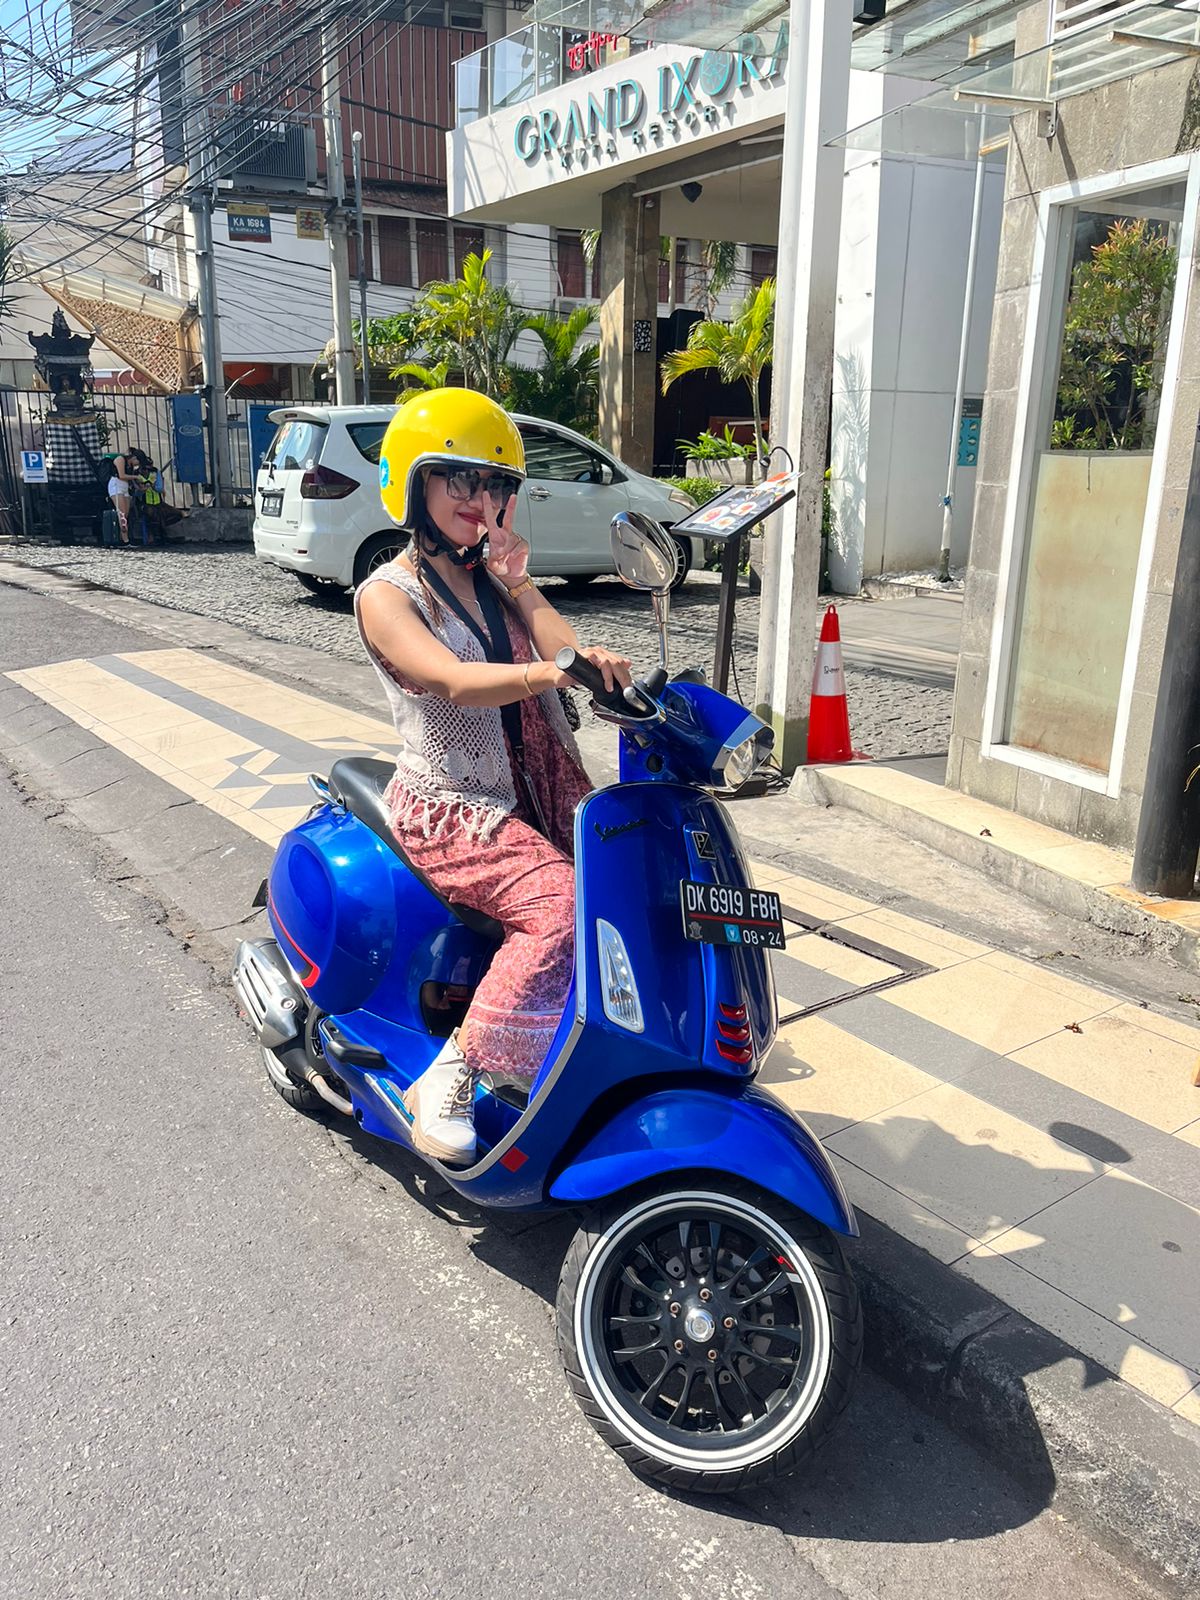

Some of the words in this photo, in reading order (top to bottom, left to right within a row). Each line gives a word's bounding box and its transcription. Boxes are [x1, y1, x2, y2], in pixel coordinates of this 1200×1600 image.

[514, 79, 644, 161] GRAND
[561, 138, 617, 168] KUTA
[632, 101, 734, 146] RESORT
[233, 217, 245, 227] KA
[247, 218, 265, 228] 1684
[29, 453, 39, 467] P
[687, 885, 707, 912] DK
[709, 888, 744, 916] 6919
[750, 893, 780, 920] FBH
